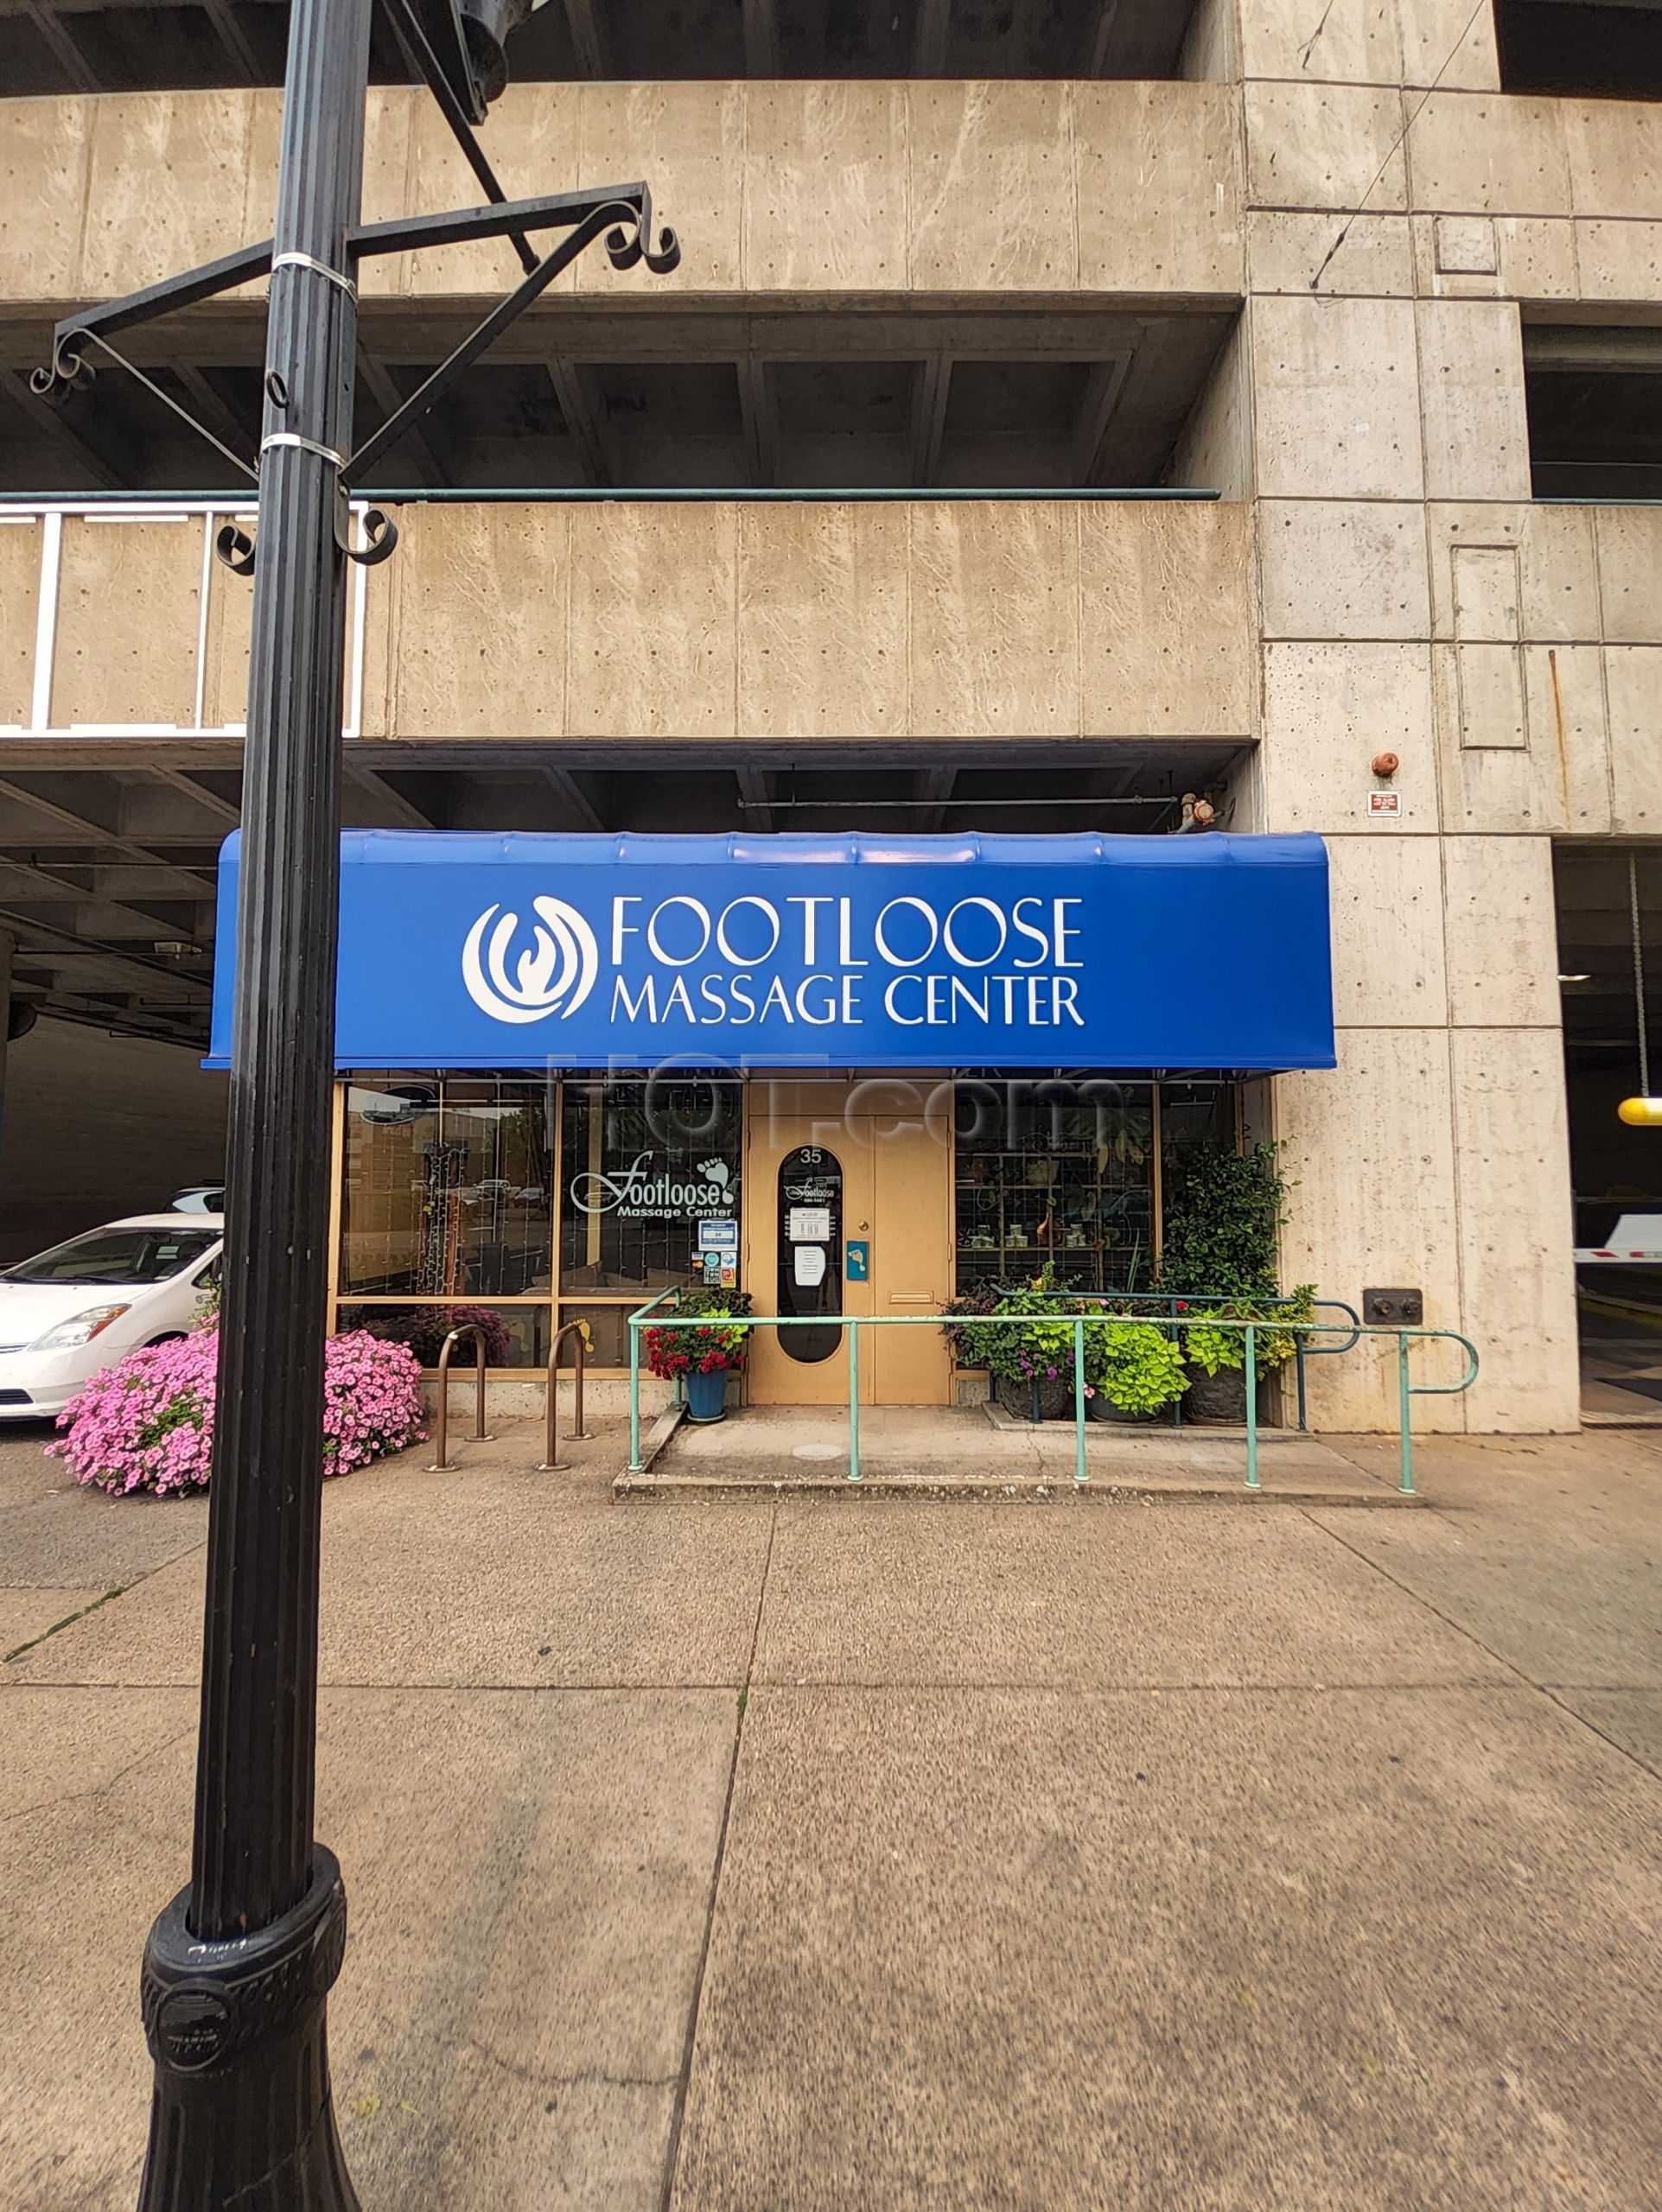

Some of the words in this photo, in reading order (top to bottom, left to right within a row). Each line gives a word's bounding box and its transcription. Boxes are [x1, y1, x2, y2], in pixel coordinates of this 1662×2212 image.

[610, 895, 1085, 969] FOOTLOOSE
[609, 974, 864, 1025] MASSAGE
[884, 975, 1086, 1026] CENTER
[800, 1148, 822, 1164] 35
[616, 1205, 681, 1219] Massage
[686, 1205, 732, 1217] Center
